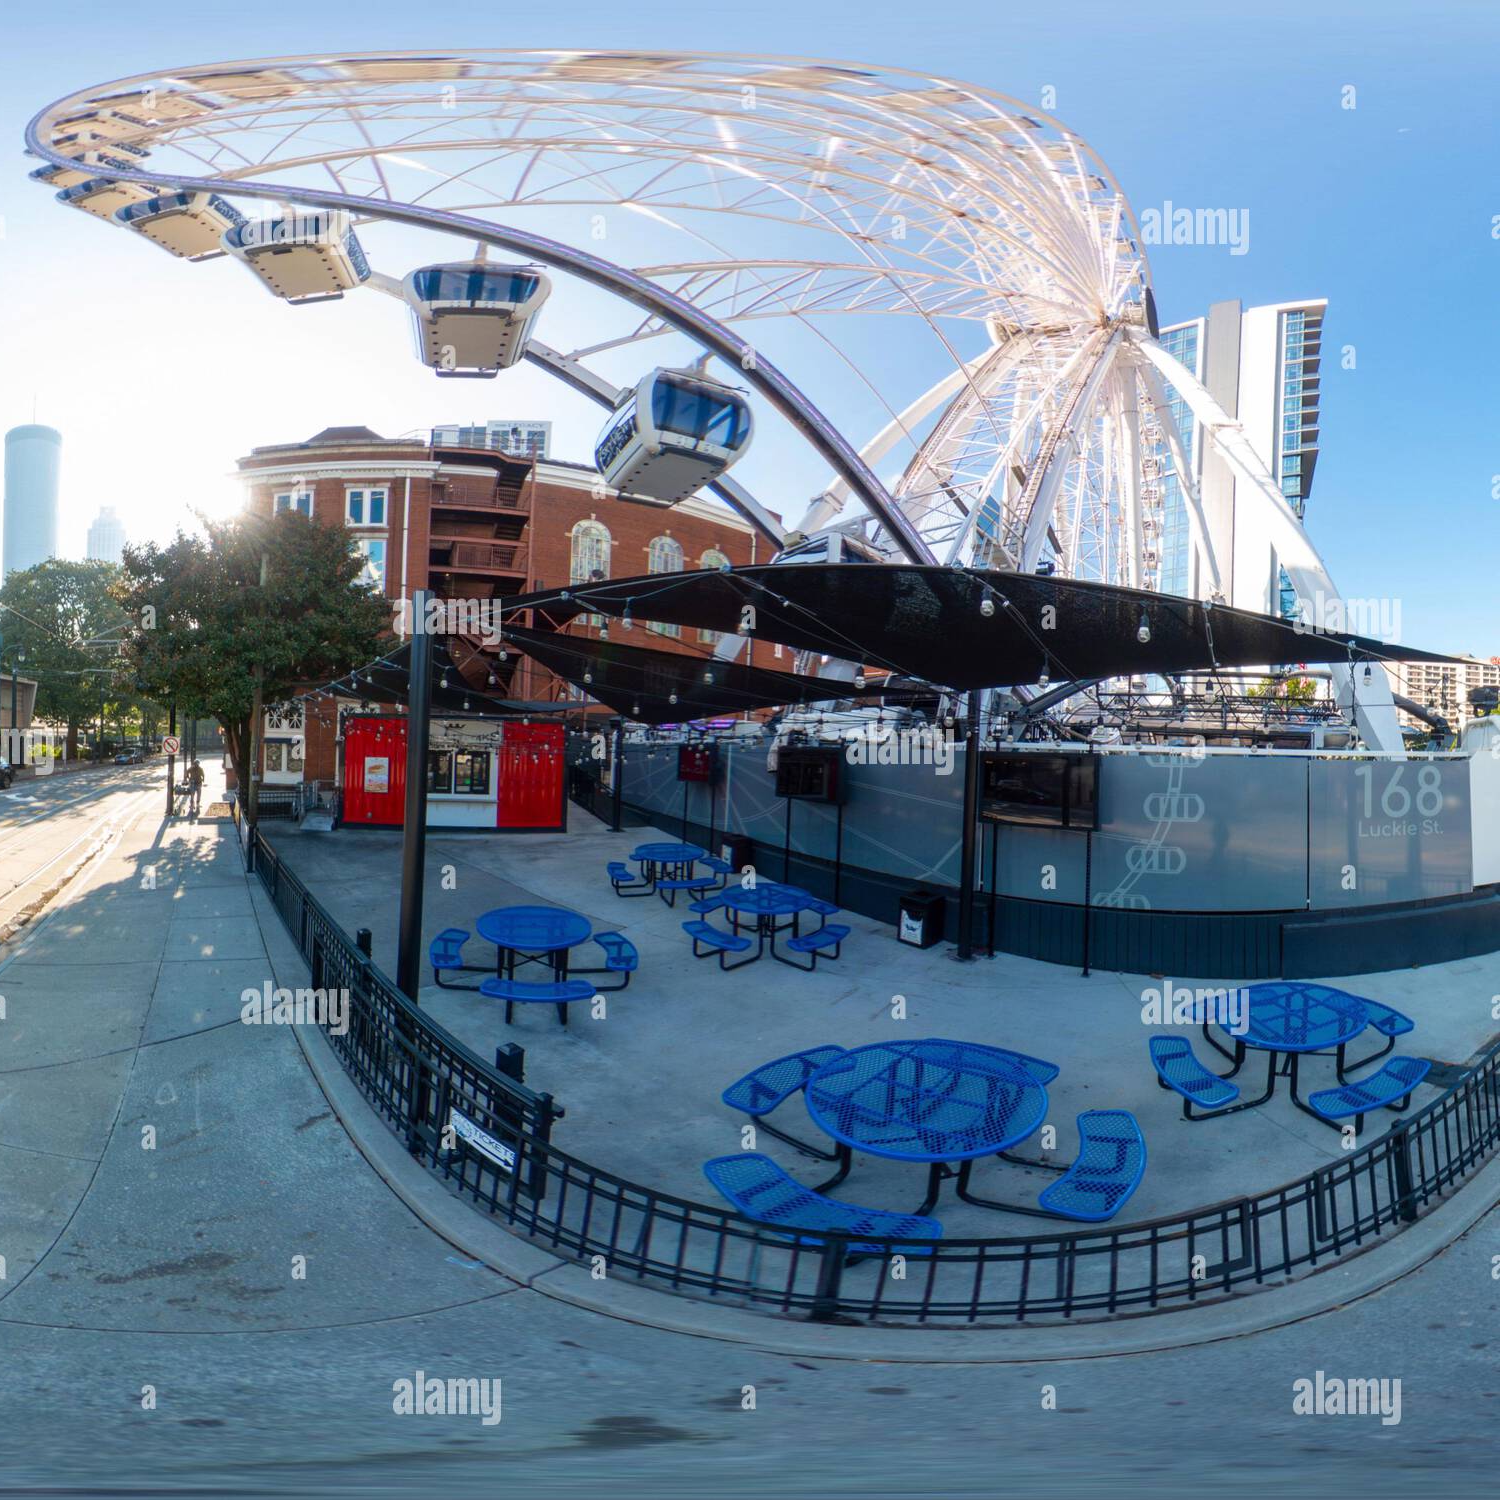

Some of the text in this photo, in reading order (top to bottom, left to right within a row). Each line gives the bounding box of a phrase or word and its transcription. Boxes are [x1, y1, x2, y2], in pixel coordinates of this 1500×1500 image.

[1355, 765, 1443, 818] 168
[1358, 818, 1444, 838] Luckie St.
